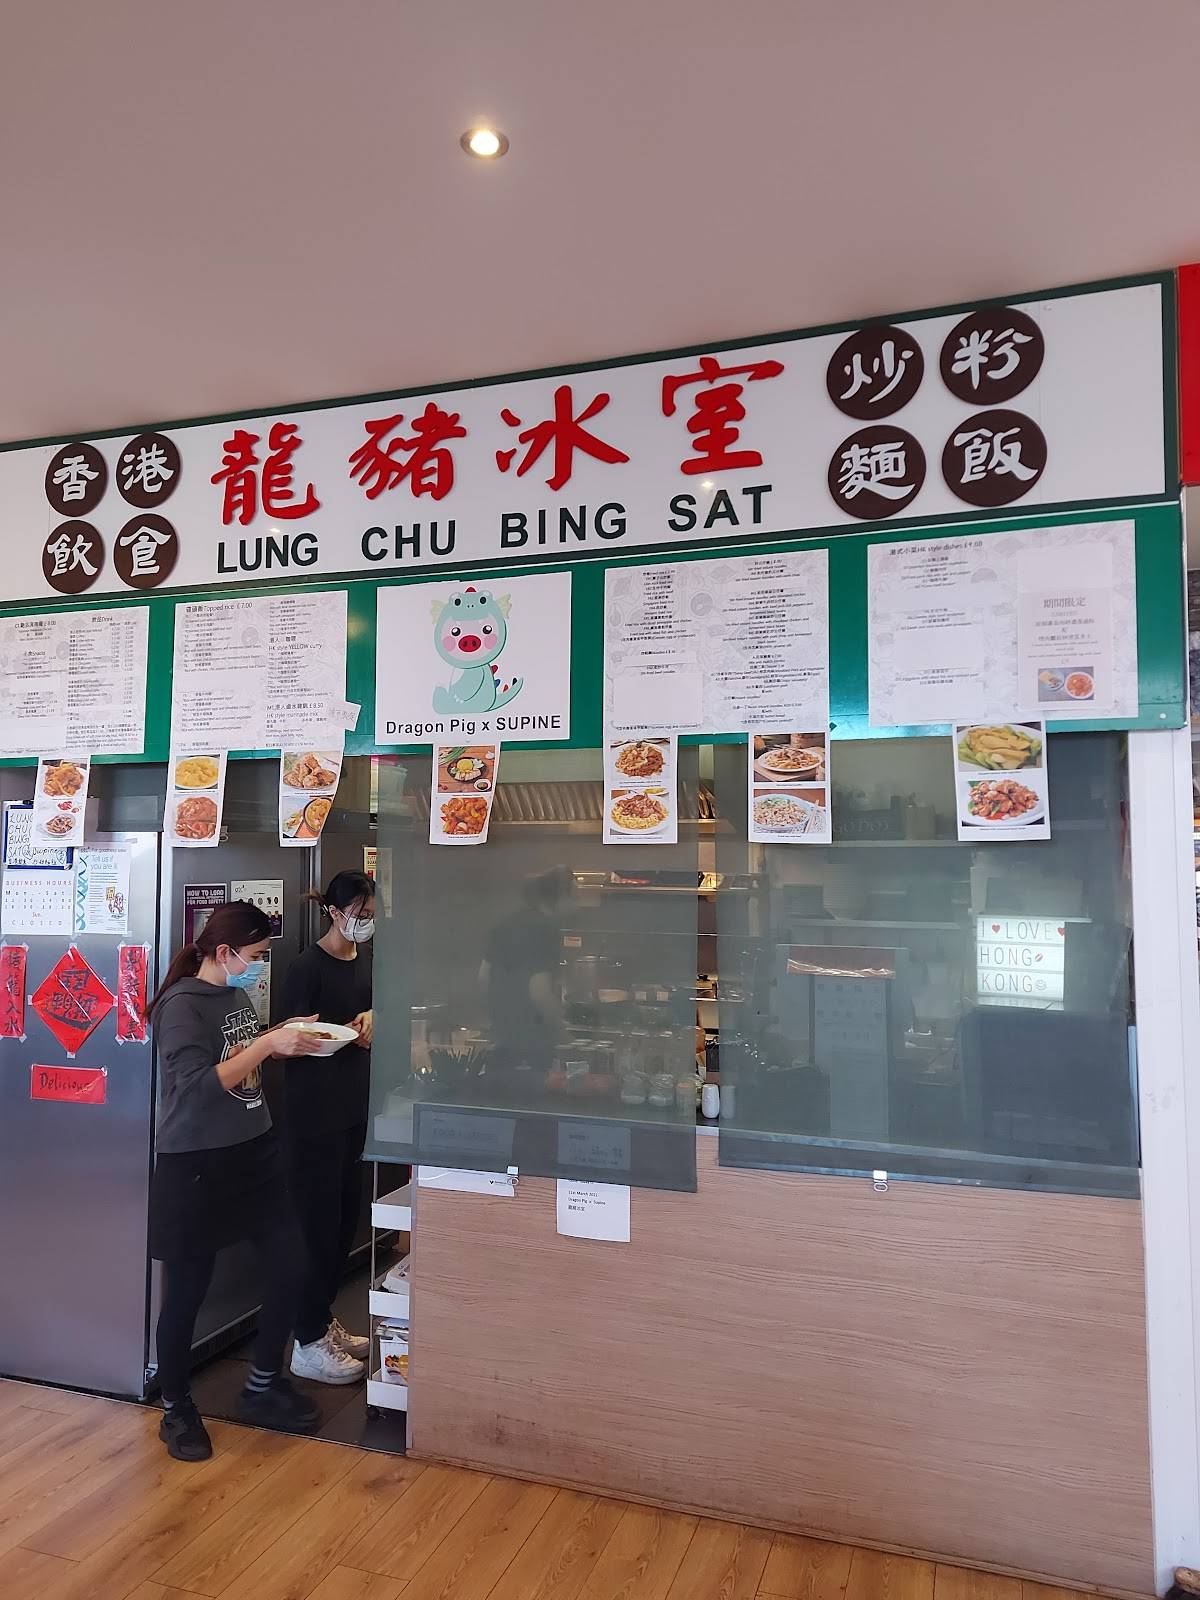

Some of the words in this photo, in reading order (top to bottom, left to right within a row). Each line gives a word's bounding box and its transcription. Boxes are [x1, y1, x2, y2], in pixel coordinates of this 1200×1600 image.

[840, 328, 1032, 403] 炒粉
[211, 357, 784, 526] 龍豬冰室
[838, 427, 1039, 499] 麵飯
[52, 443, 174, 502] 香港
[48, 528, 171, 580] 飲食
[216, 533, 319, 574] LUNG
[361, 520, 456, 560] CHU
[500, 502, 627, 548] BING
[668, 485, 772, 532] SAT
[386, 721, 444, 736] Dragon
[450, 719, 476, 734] Pig
[481, 722, 490, 731] x
[496, 715, 561, 730] SUPINE
[980, 946, 1032, 966] HONG
[1006, 922, 1051, 940] LOVE
[982, 974, 1033, 992] KONG
[221, 1007, 257, 1030] STAR
